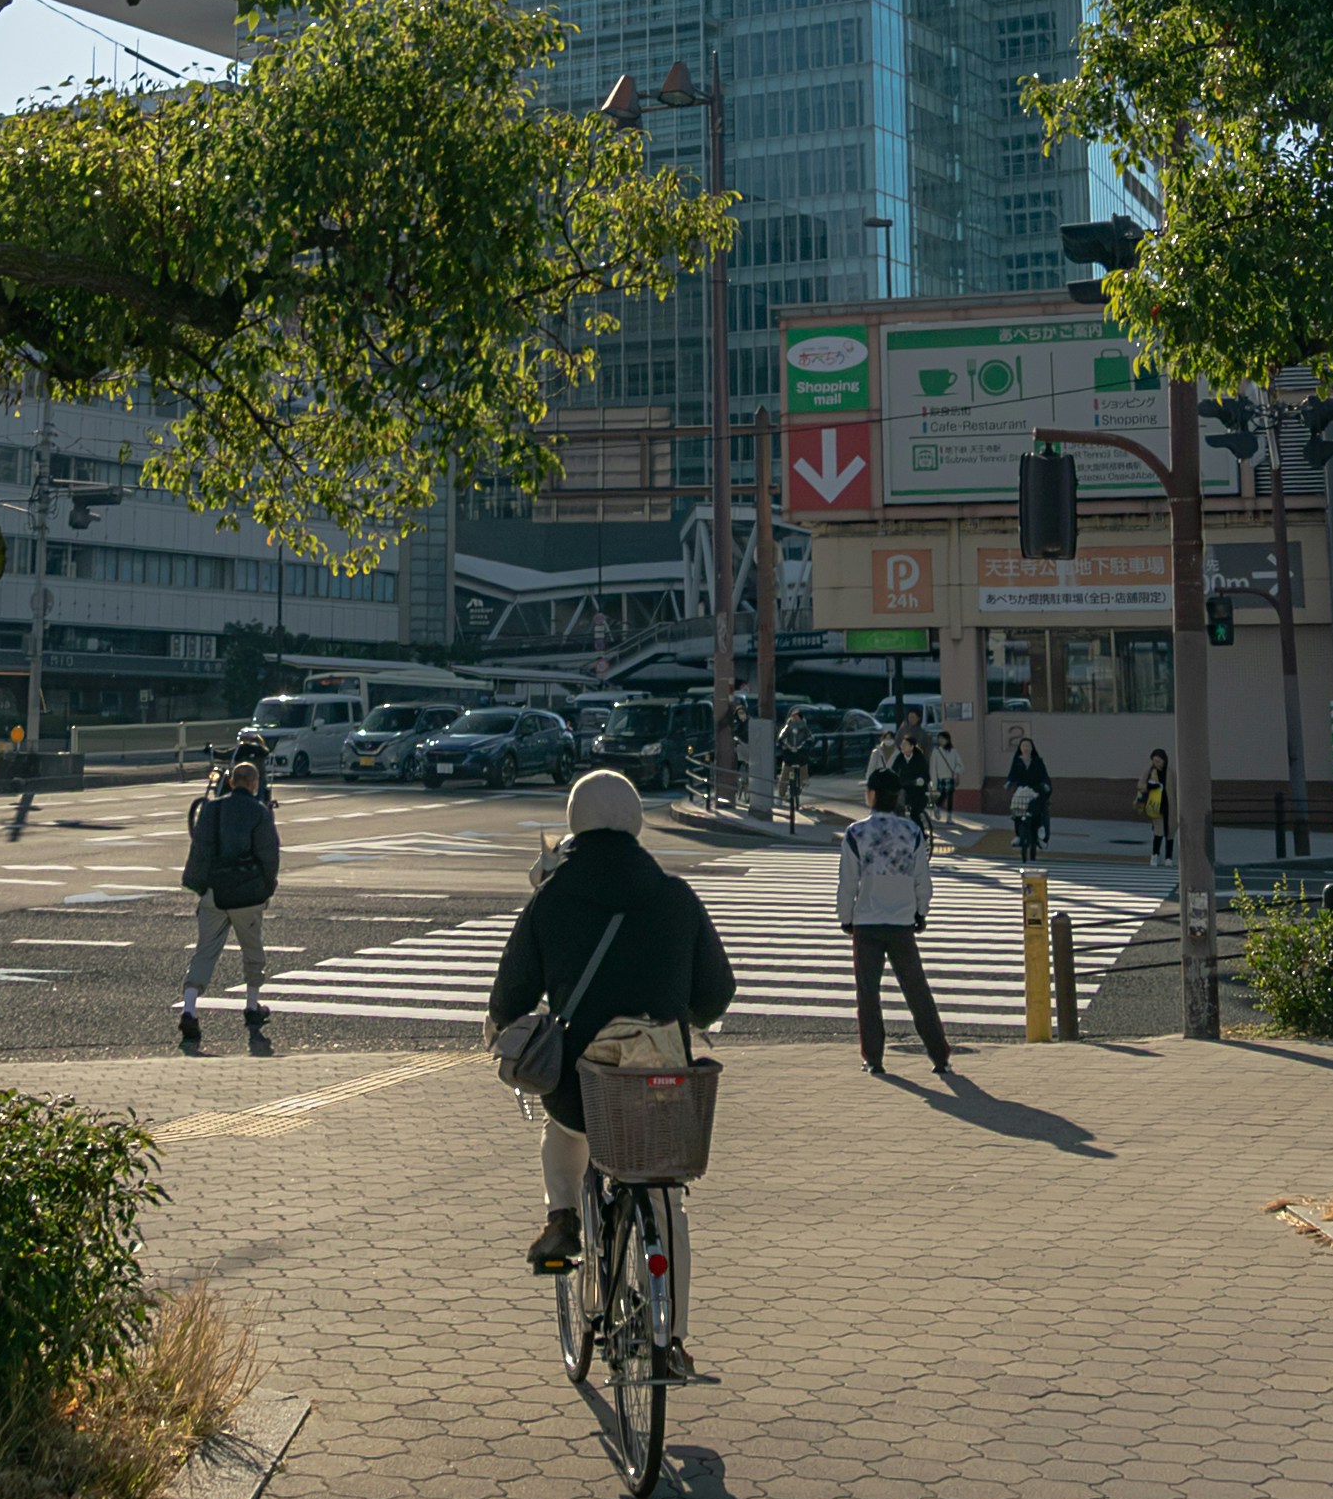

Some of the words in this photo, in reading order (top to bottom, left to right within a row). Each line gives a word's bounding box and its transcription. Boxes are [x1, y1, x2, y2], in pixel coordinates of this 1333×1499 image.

[796, 380, 861, 394] Shopping
[814, 393, 842, 406] mall
[1102, 397, 1157, 410] ショッピング
[1102, 414, 1158, 427] Shopping
[886, 593, 919, 609] 24h
